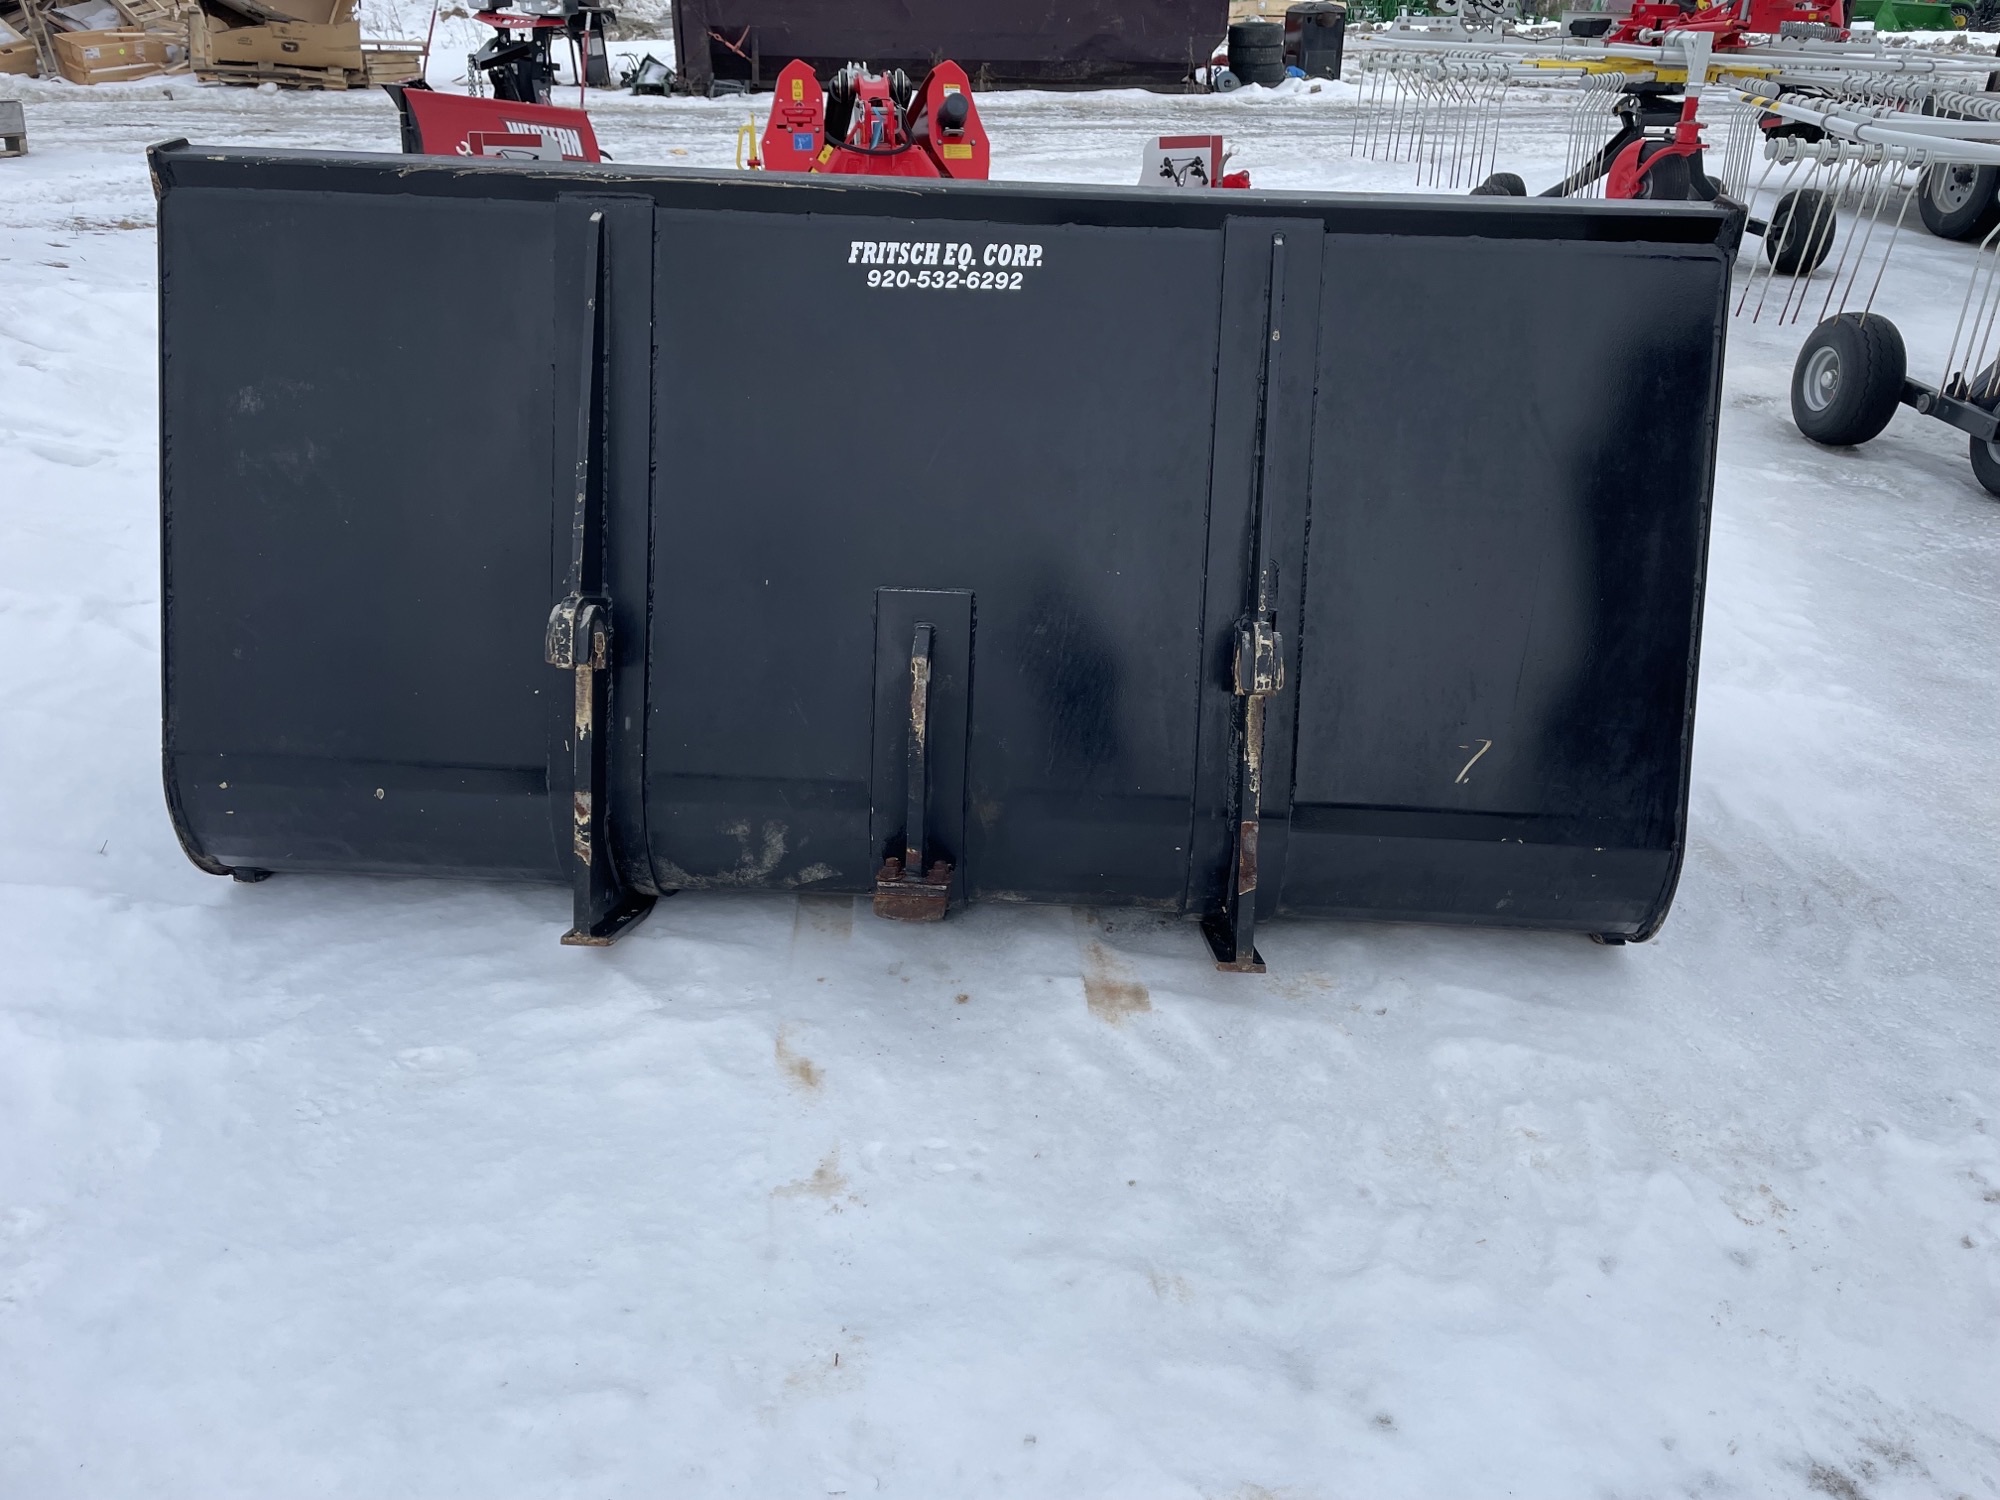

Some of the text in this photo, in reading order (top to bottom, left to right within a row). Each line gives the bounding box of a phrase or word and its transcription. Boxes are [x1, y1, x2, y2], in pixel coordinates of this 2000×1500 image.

[848, 241, 1043, 271] FRITSCH EQ. CORP.
[867, 269, 1024, 290] 920-532-6292
